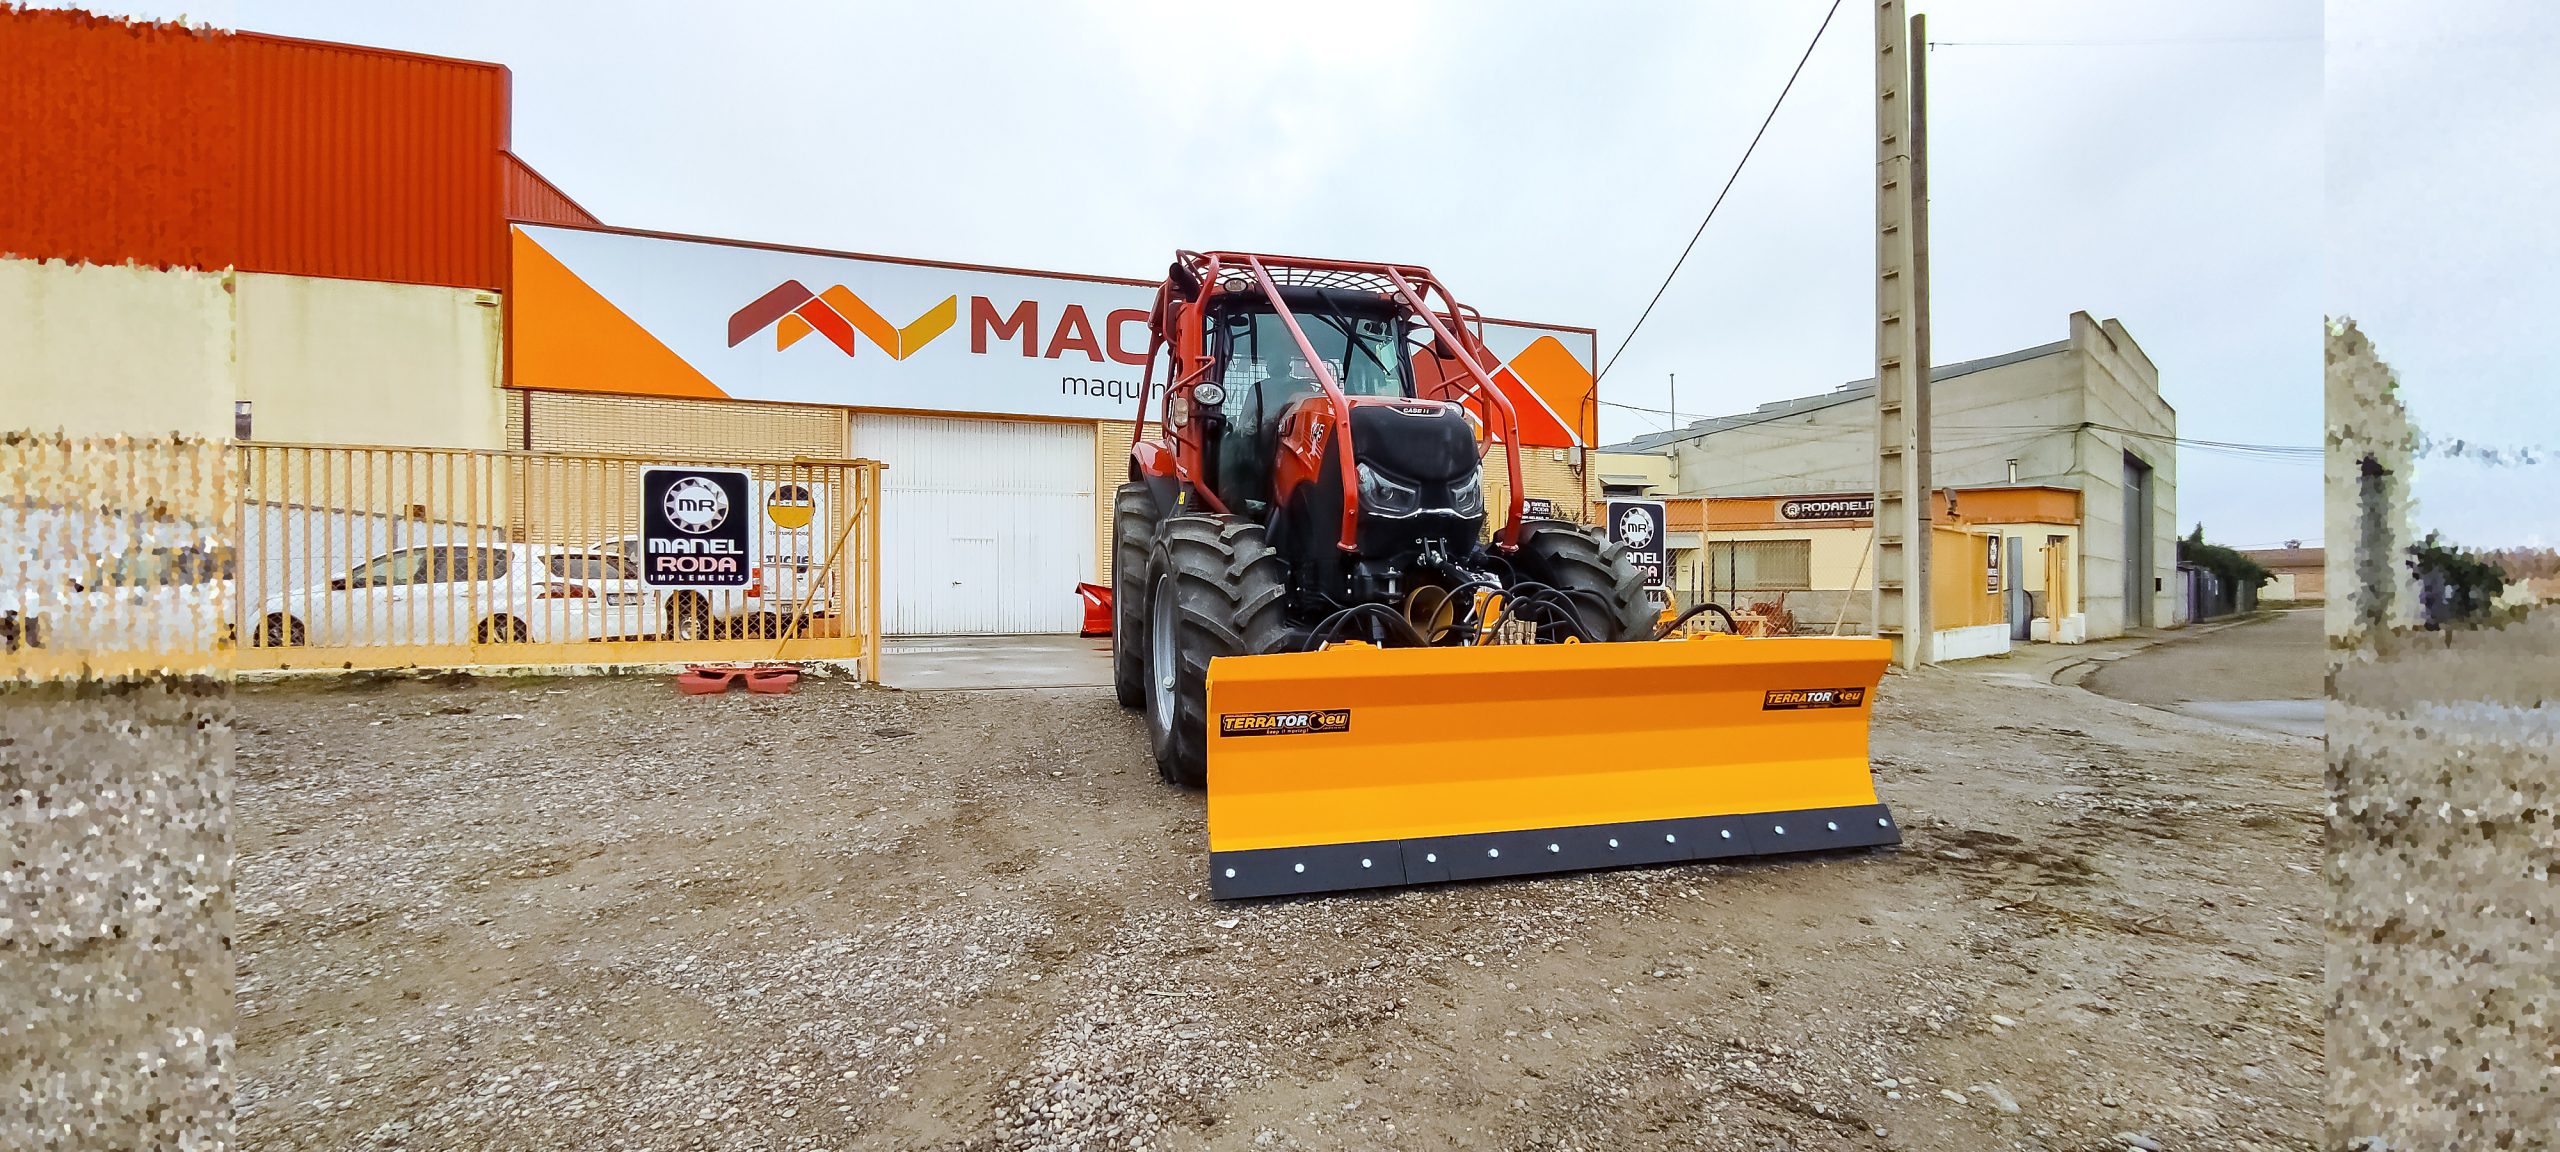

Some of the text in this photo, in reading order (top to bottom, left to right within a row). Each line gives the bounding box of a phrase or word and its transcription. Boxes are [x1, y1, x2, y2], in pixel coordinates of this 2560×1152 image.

[1062, 376, 1166, 405] maqun
[678, 498, 716, 512] MR
[1627, 523, 1647, 533] MR
[648, 538, 744, 554] MANEL
[656, 556, 737, 573] RODA
[1625, 551, 1662, 564] ANEL
[650, 574, 744, 582] IMPLEMENTS
[1768, 692, 1832, 704] TERRATOR
[1225, 715, 1309, 729] TERRATOR
